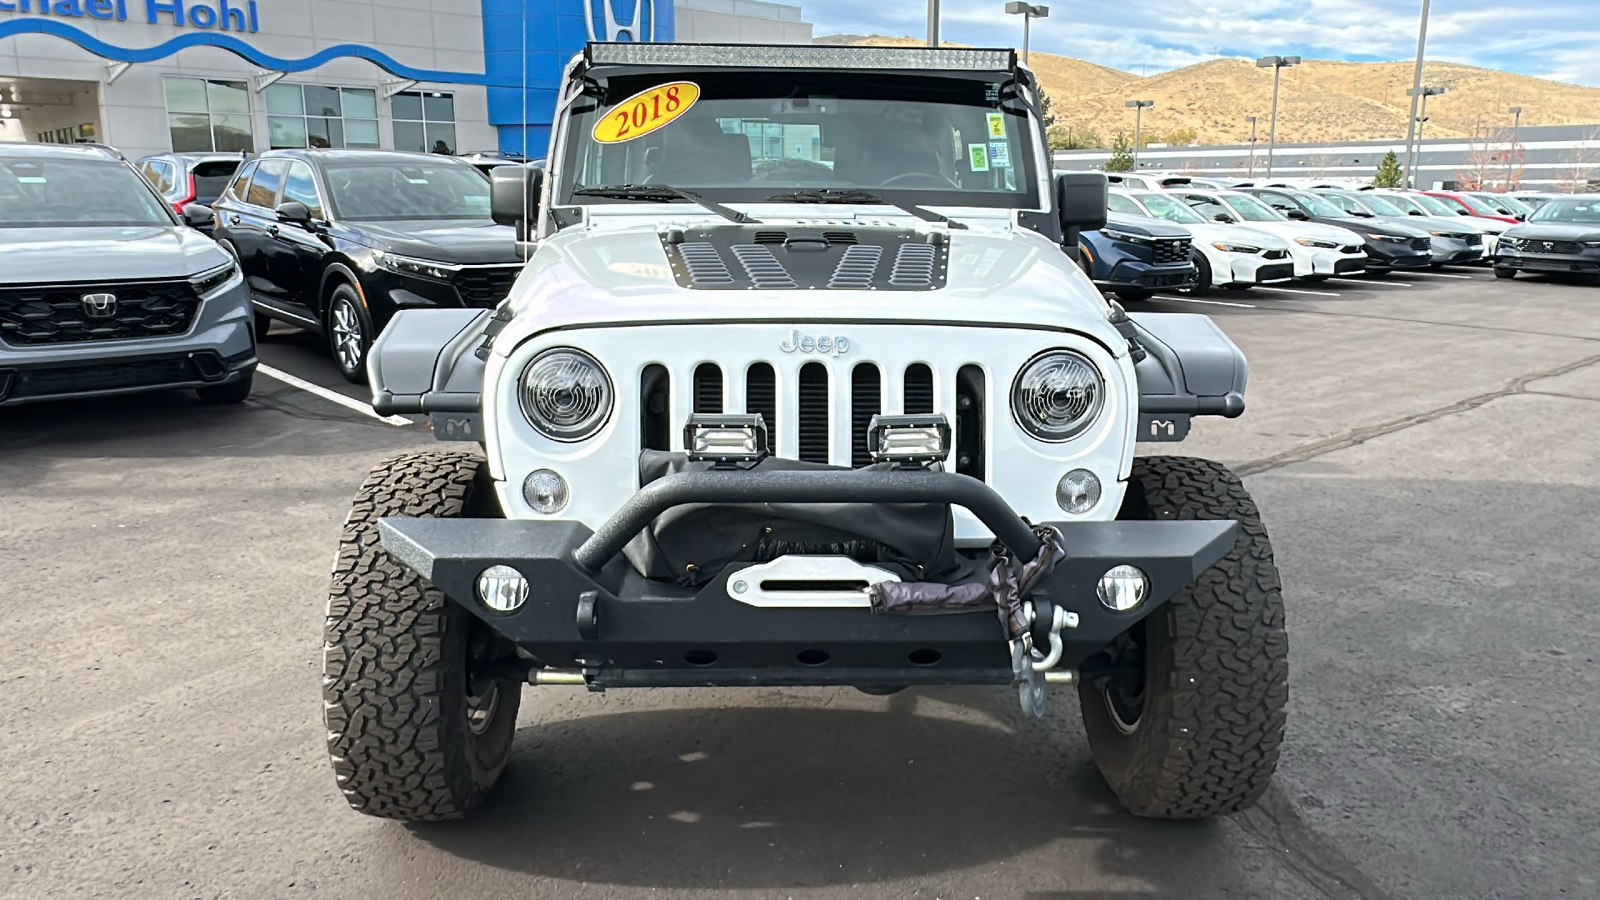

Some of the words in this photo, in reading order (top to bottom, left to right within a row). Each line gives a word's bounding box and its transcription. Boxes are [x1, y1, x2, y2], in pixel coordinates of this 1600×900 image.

[147, 0, 259, 33] Hohl
[614, 86, 681, 138] 2018
[779, 328, 850, 359] Jeep
